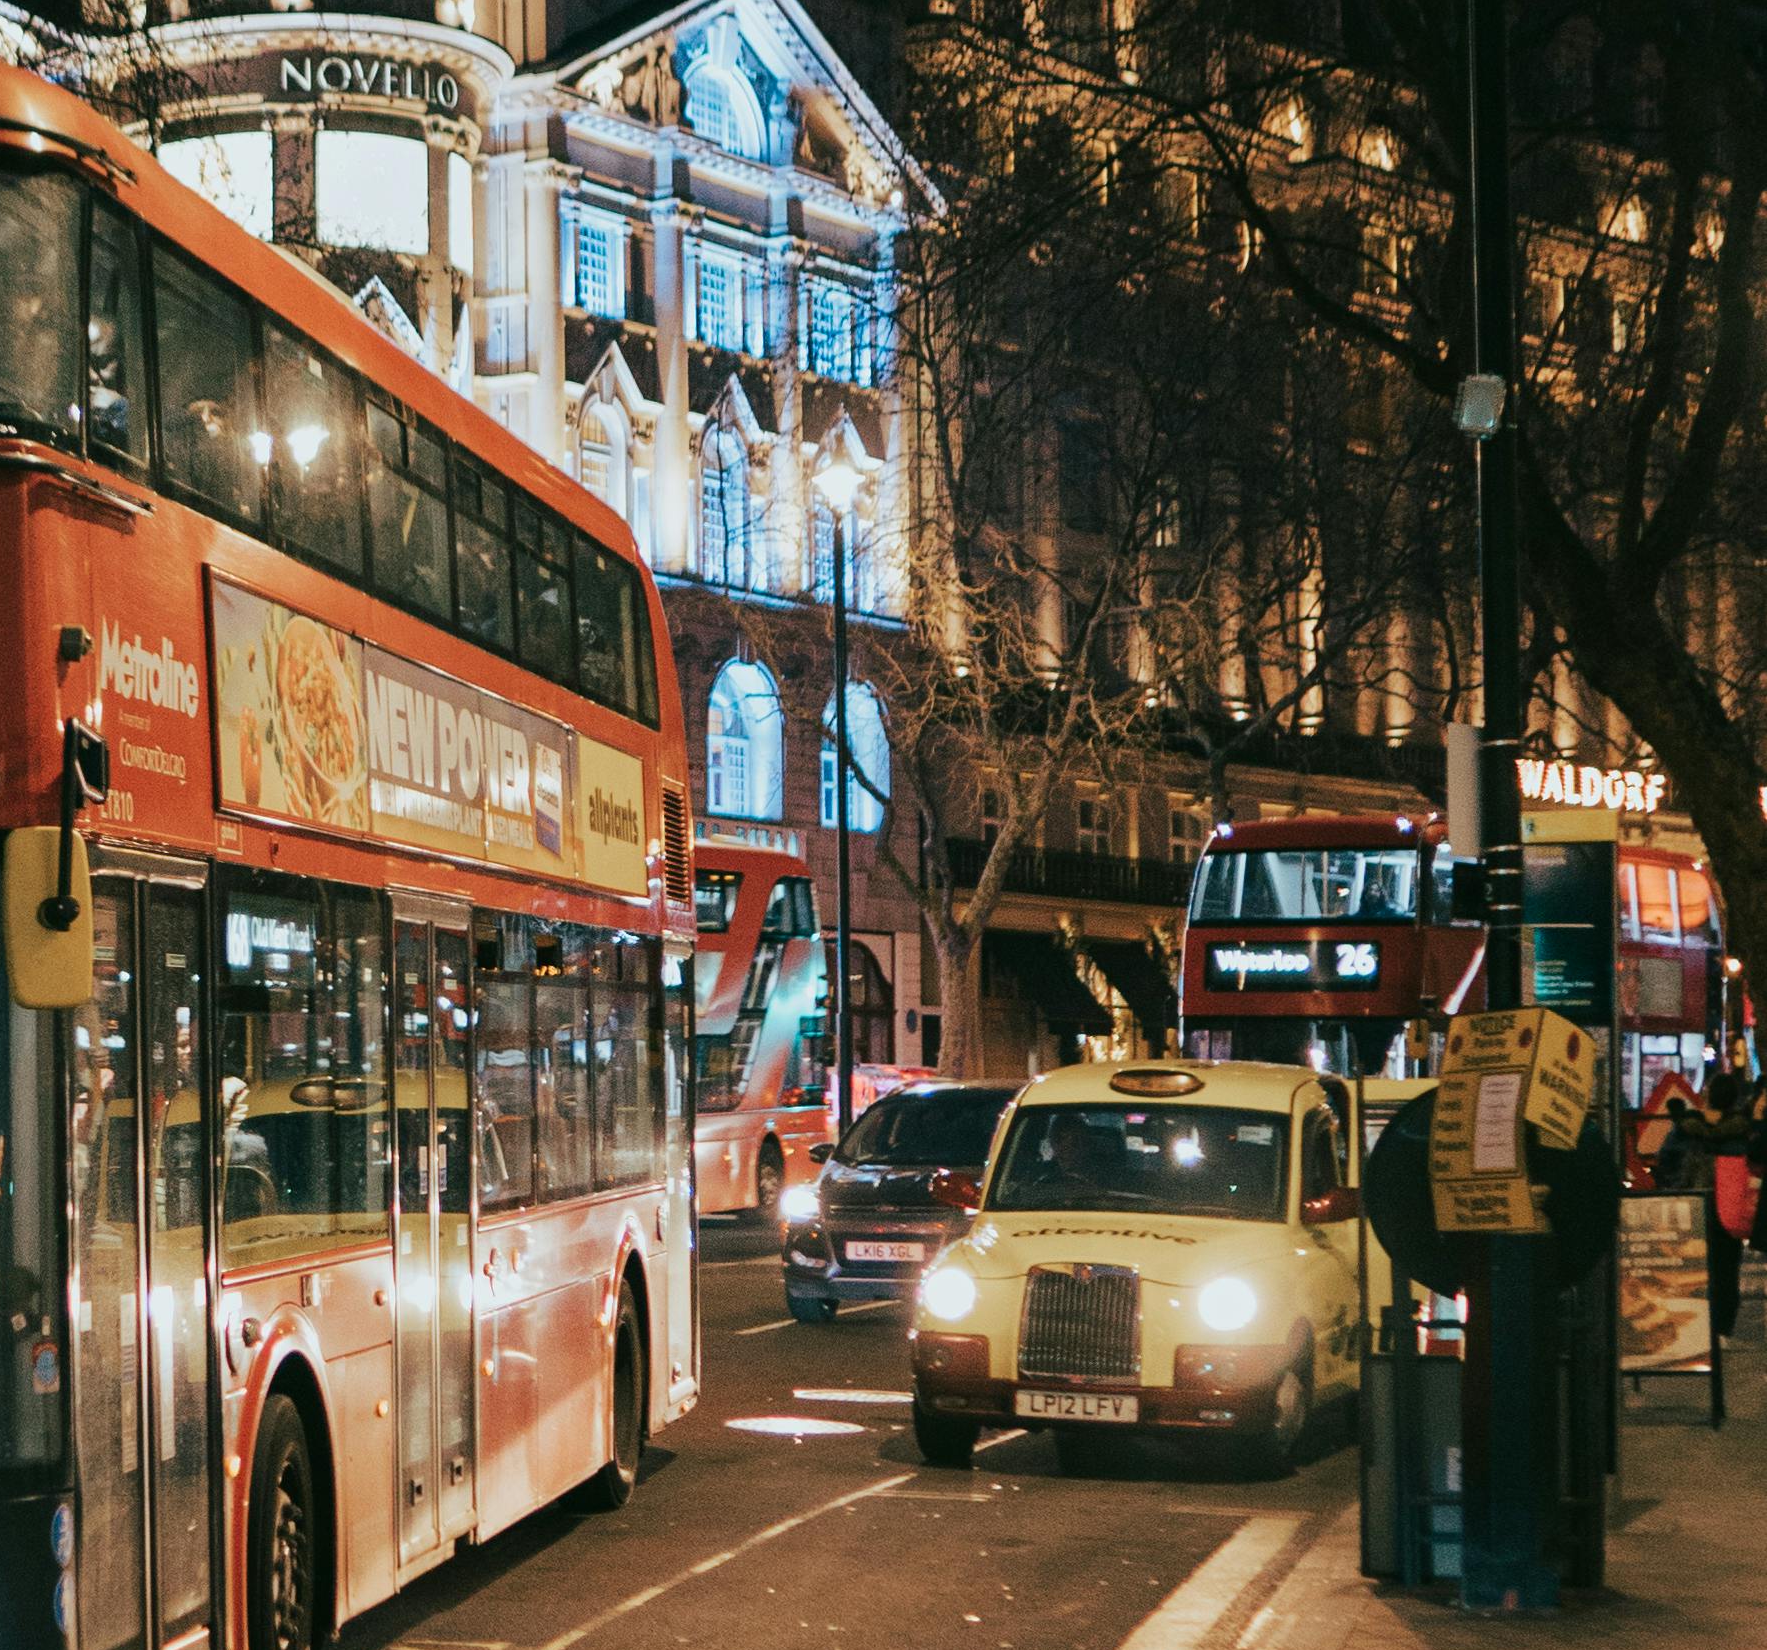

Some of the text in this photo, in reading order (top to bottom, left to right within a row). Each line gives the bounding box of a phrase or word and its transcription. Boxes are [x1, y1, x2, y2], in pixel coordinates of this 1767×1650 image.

[281, 57, 459, 108] NOVELLO
[101, 615, 200, 720] Metroline
[365, 669, 435, 789] NEW
[437, 699, 533, 818] POWER
[1515, 758, 1666, 814] WALDORF
[589, 787, 639, 846] allplants
[1214, 943, 1377, 977] Waterloo 26
[855, 1245, 915, 1258] LK16 XGL
[1011, 1223, 1196, 1246] attentive
[1030, 1395, 1123, 1418] LP12 LFV
